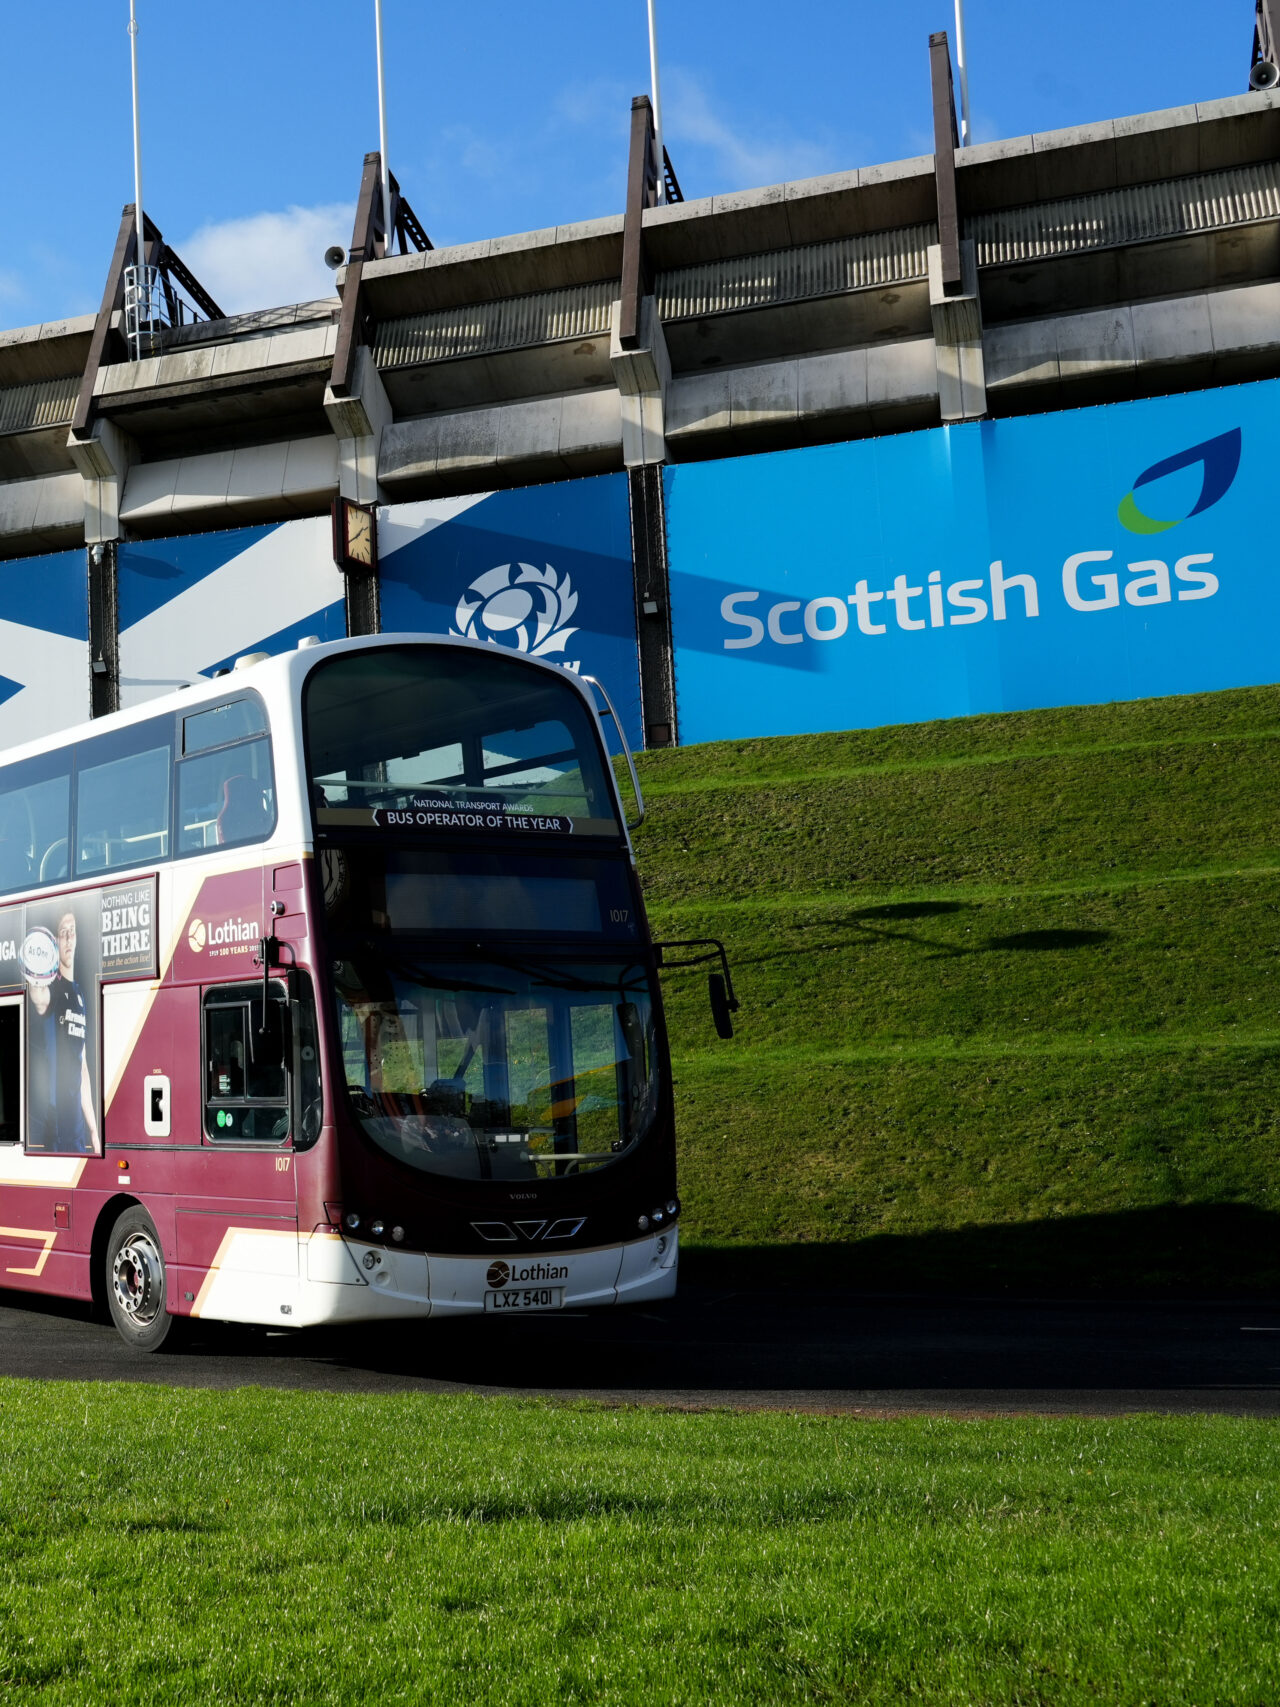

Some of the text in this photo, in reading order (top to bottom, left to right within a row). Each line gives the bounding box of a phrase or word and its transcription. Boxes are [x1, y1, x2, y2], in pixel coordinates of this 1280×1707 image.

[721, 550, 1220, 649] Scottish Gas
[413, 799, 534, 812] NATIONAL TRANSPORT AWARDS
[387, 811, 562, 831] BUS OPERATOR OF THE YEAR
[102, 889, 150, 910] NOTHING LIKE
[102, 904, 150, 933] BEING
[610, 909, 629, 922] 1017
[208, 917, 259, 945] Lothian
[102, 928, 151, 957] THERE
[230, 944, 249, 954] YEARS
[275, 1157, 290, 1171] 1017
[512, 1263, 568, 1281] Lothian
[493, 1290, 552, 1308] LXZ 5401
